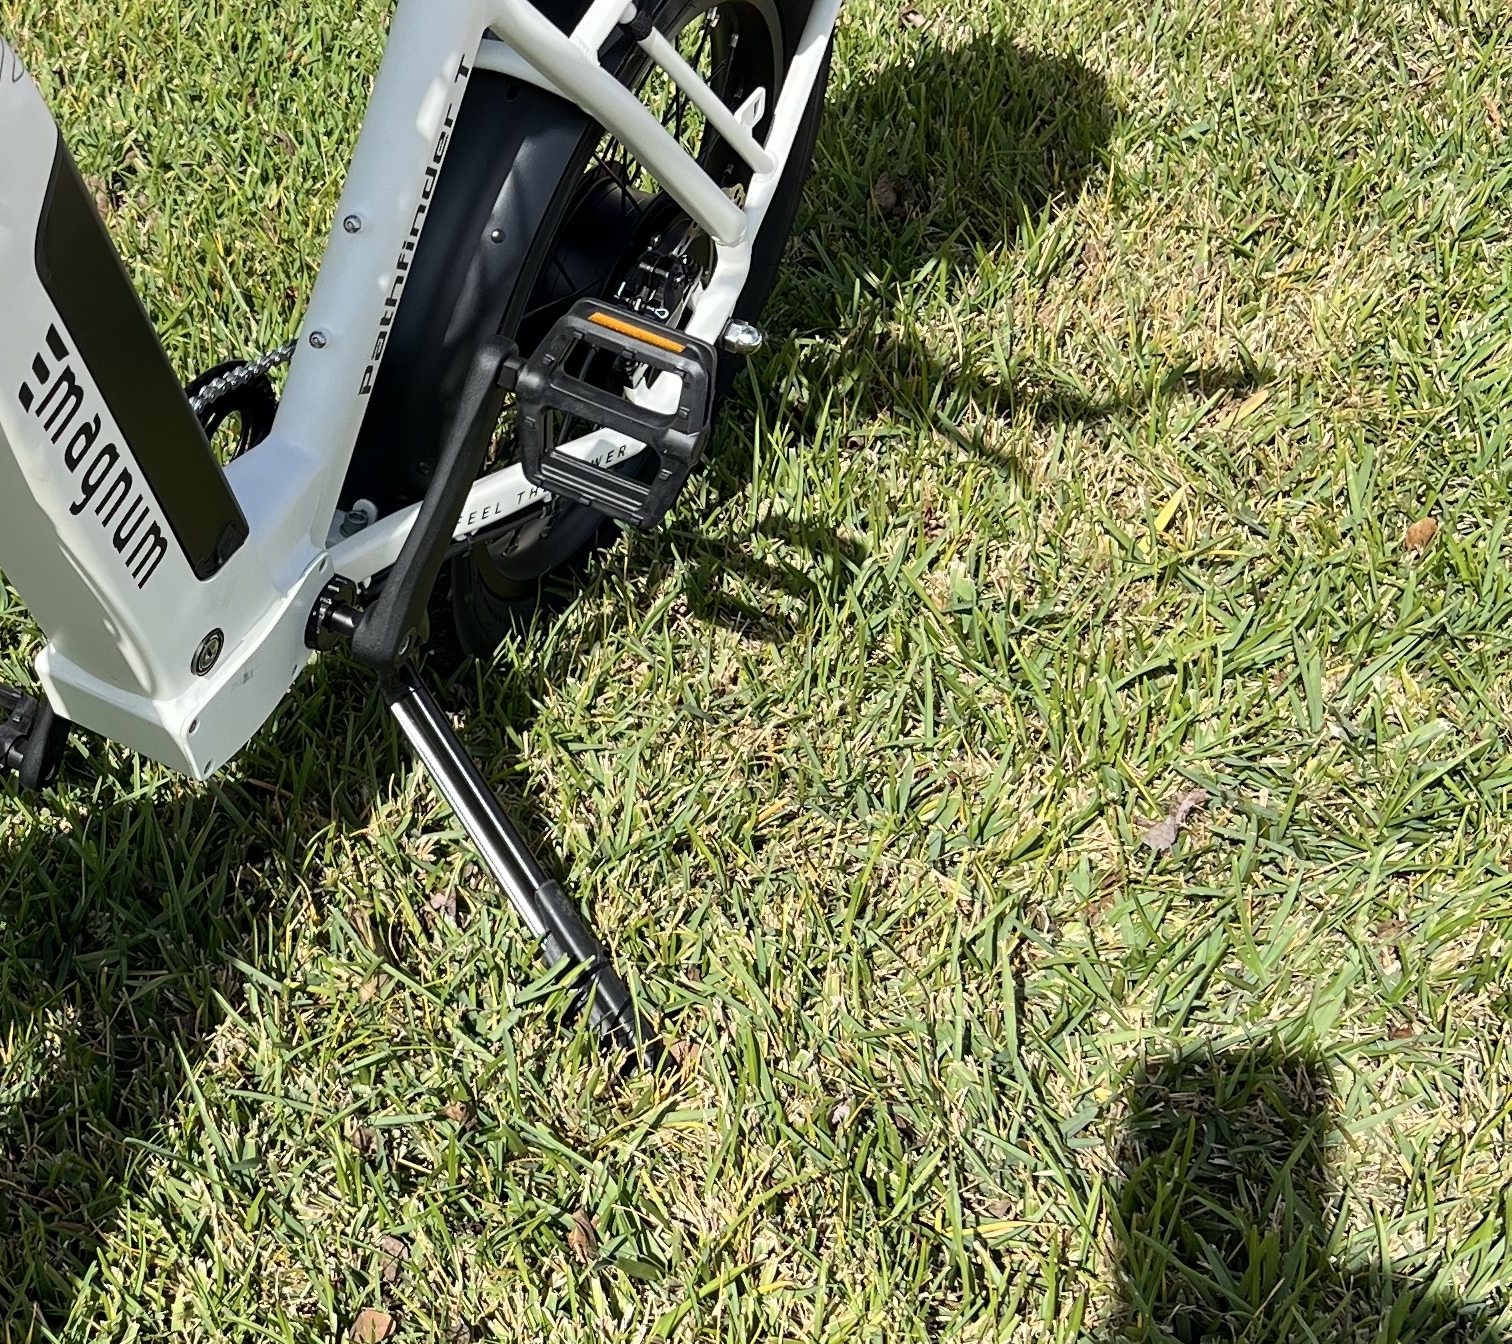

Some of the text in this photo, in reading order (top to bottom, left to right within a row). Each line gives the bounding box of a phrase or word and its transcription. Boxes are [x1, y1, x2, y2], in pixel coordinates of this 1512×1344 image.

[358, 102, 453, 395] pathfinder
[34, 364, 168, 589] magnum
[517, 487, 548, 505] TH
